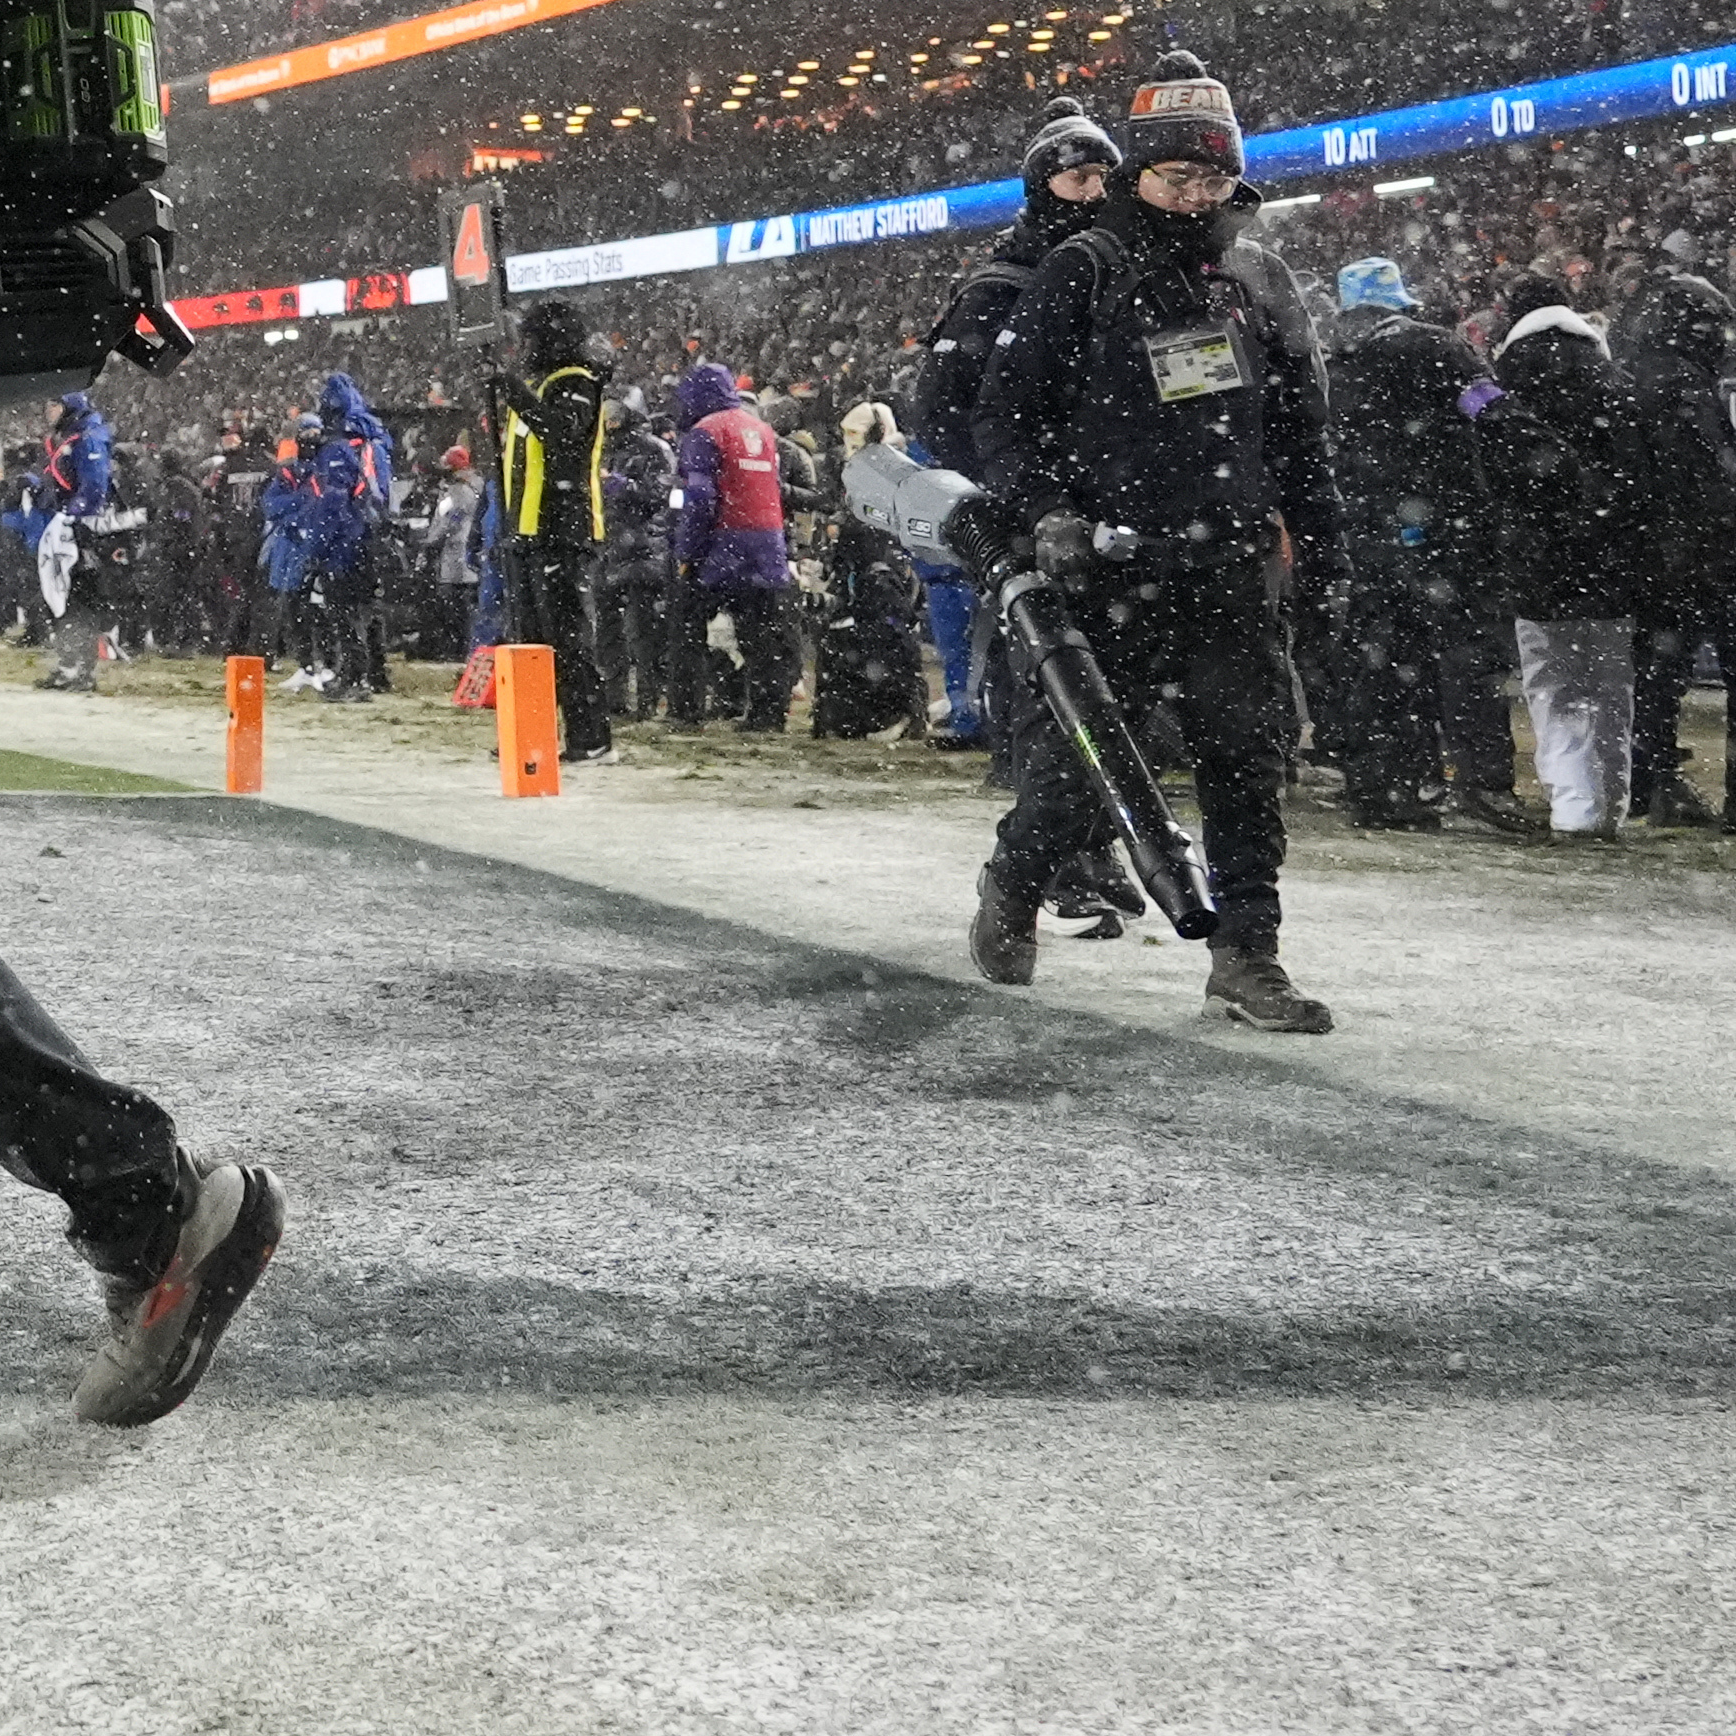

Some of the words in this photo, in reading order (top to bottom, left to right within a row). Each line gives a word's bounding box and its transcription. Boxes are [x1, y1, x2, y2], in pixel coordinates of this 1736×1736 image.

[1152, 88, 1235, 111] BEAR
[1671, 63, 1690, 106] 0
[1694, 62, 1728, 102] INT
[1491, 96, 1508, 137] 0
[1512, 98, 1535, 135] TD
[1323, 126, 1346, 167] 10
[1349, 127, 1378, 163] ATT
[453, 203, 490, 287] 4
[728, 214, 797, 265] LA
[809, 211, 875, 247] MATTHEW
[875, 195, 949, 238] STAFFORD
[509, 262, 542, 286] Game
[544, 257, 590, 286] Passing
[592, 250, 624, 276] Stats
